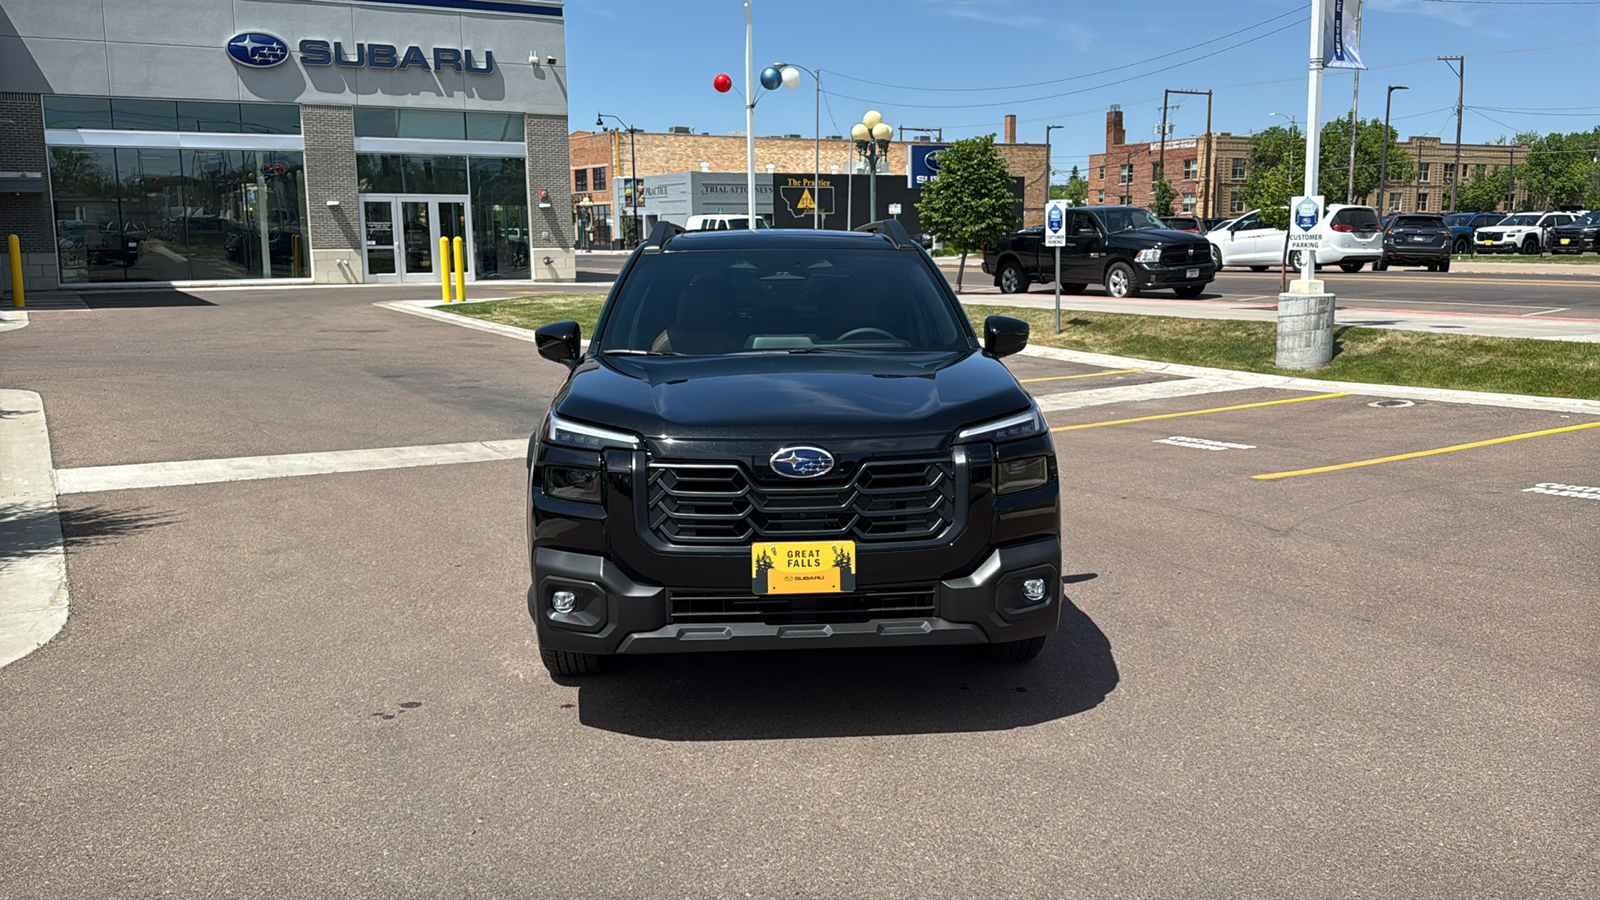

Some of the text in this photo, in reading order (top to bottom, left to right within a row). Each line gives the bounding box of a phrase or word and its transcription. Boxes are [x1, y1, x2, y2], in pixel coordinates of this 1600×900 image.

[299, 39, 493, 74] SUBARU
[787, 178, 831, 186] The Pratice
[645, 186, 668, 196] PRACTICE
[704, 186, 728, 194] TRIAL
[787, 550, 821, 559] GREAT
[787, 559, 821, 567] FALLS
